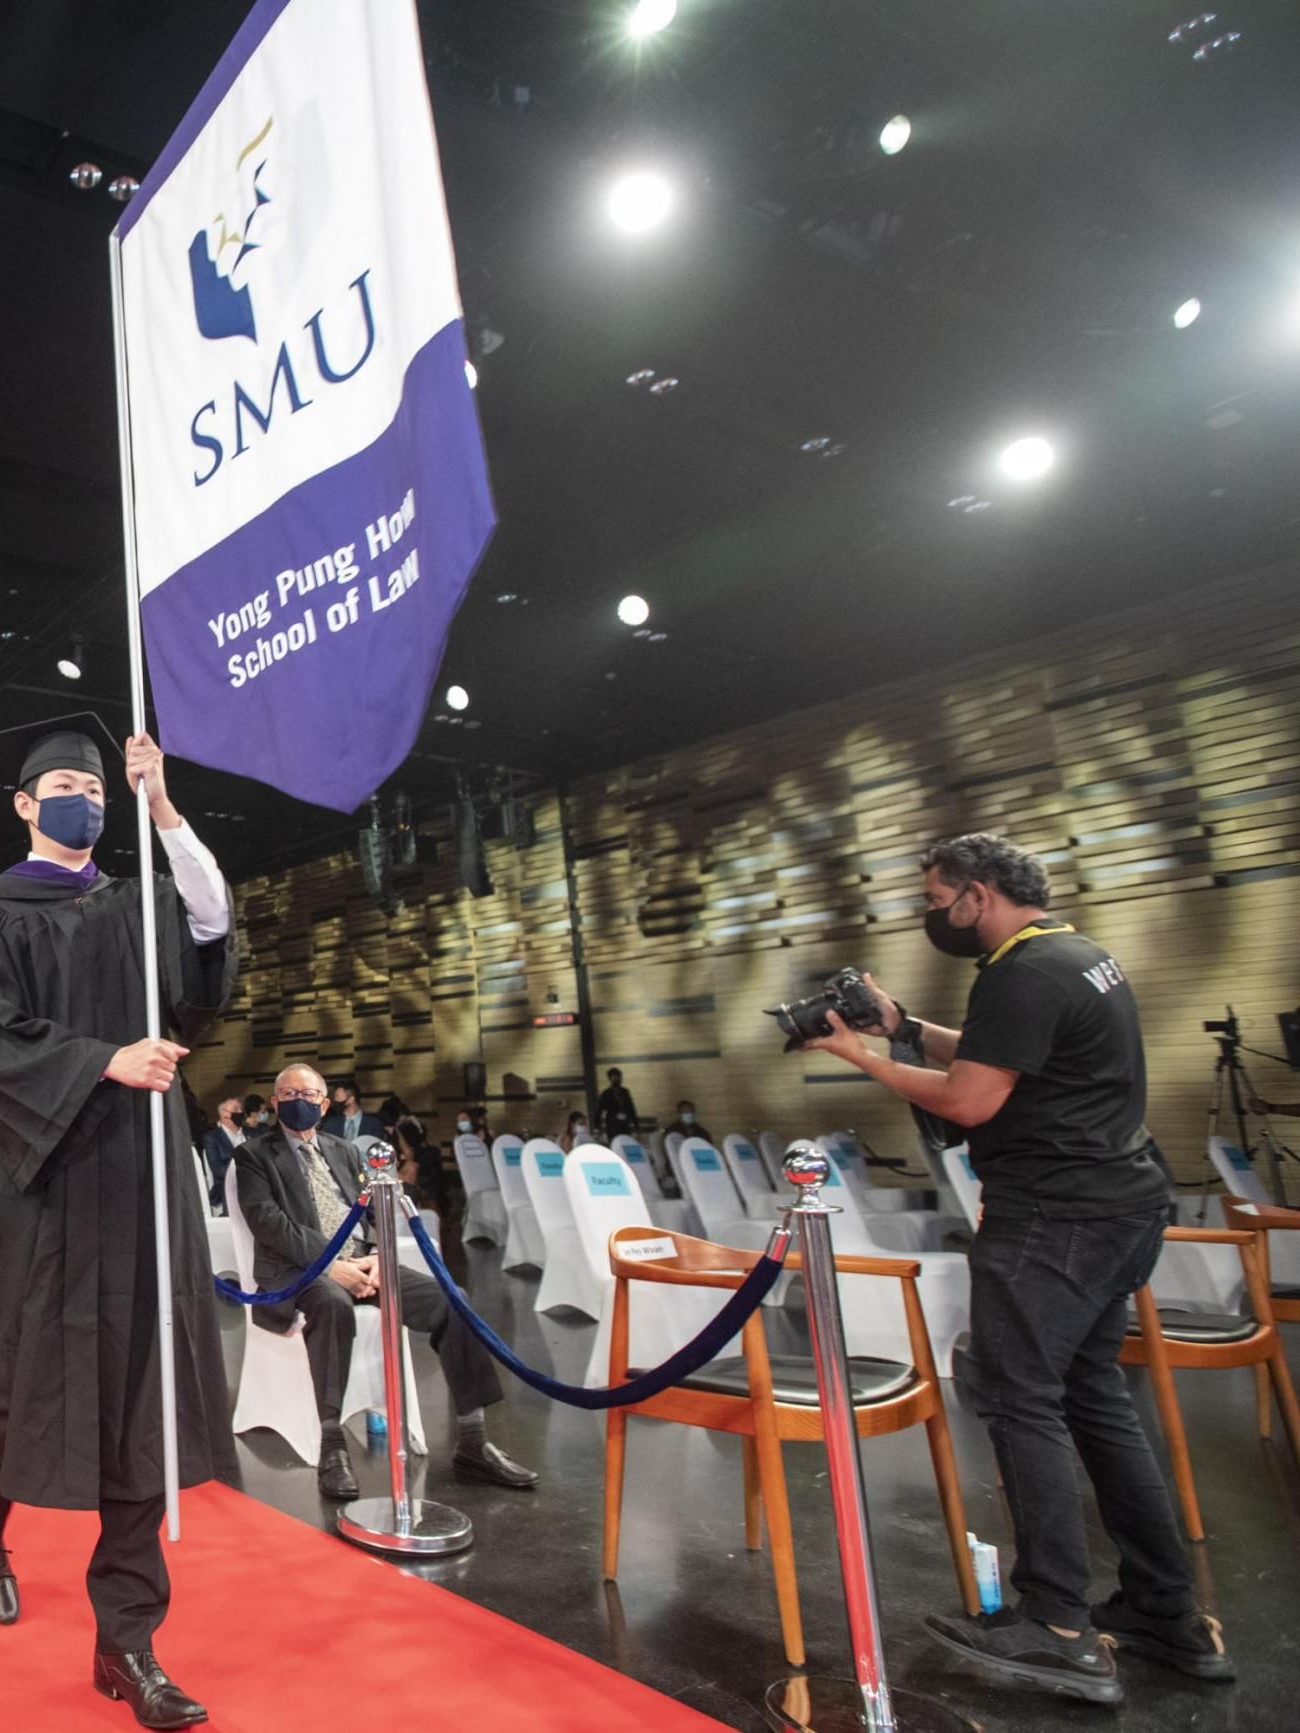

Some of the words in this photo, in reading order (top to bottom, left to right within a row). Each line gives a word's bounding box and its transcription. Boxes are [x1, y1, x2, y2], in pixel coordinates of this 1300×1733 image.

[190, 268, 375, 487] SMU
[207, 589, 272, 648] Yong
[275, 542, 360, 607] Pung
[364, 487, 416, 561] How
[227, 608, 317, 688] School
[325, 586, 360, 633] of
[367, 548, 420, 613] Law
